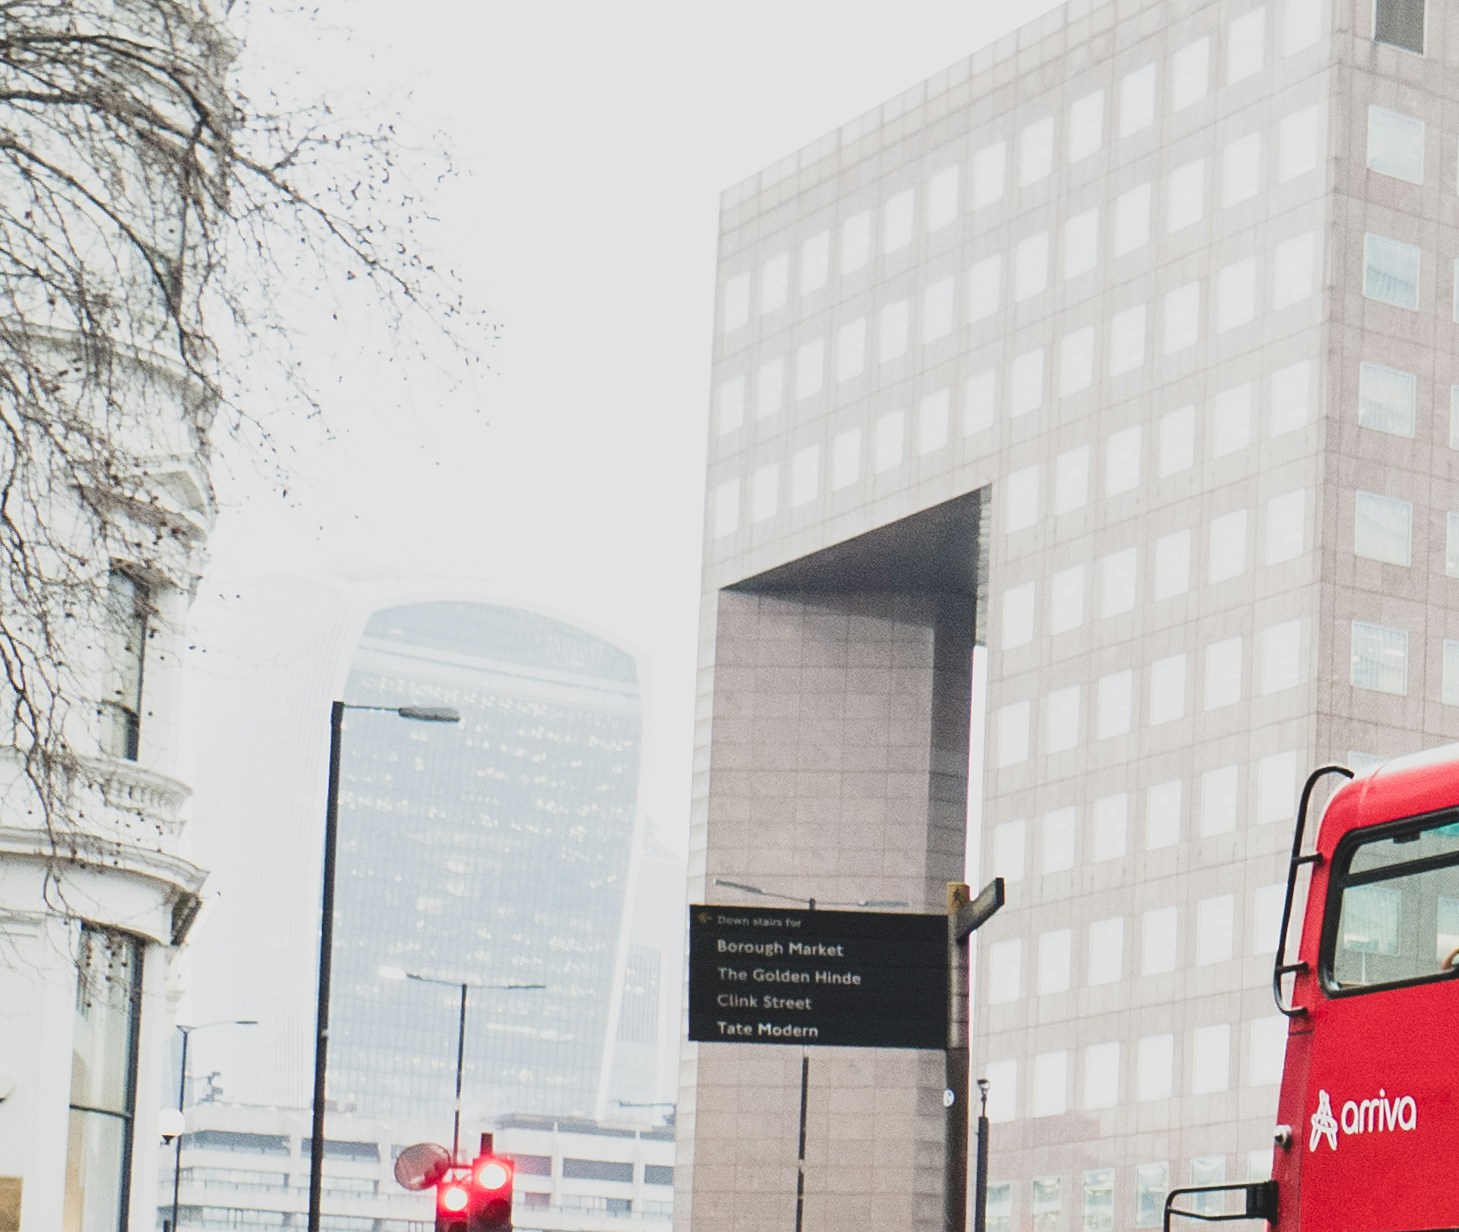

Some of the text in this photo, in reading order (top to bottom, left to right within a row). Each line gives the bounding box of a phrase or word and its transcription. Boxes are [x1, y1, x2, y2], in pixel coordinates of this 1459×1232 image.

[717, 914, 802, 929] Down stairs for
[717, 938, 844, 958] Borough Market
[717, 966, 862, 986] The Golden Hinde
[717, 993, 813, 1010] Clink Street
[717, 1020, 819, 1039] Tate Modern
[1340, 1087, 1418, 1136] arriva
